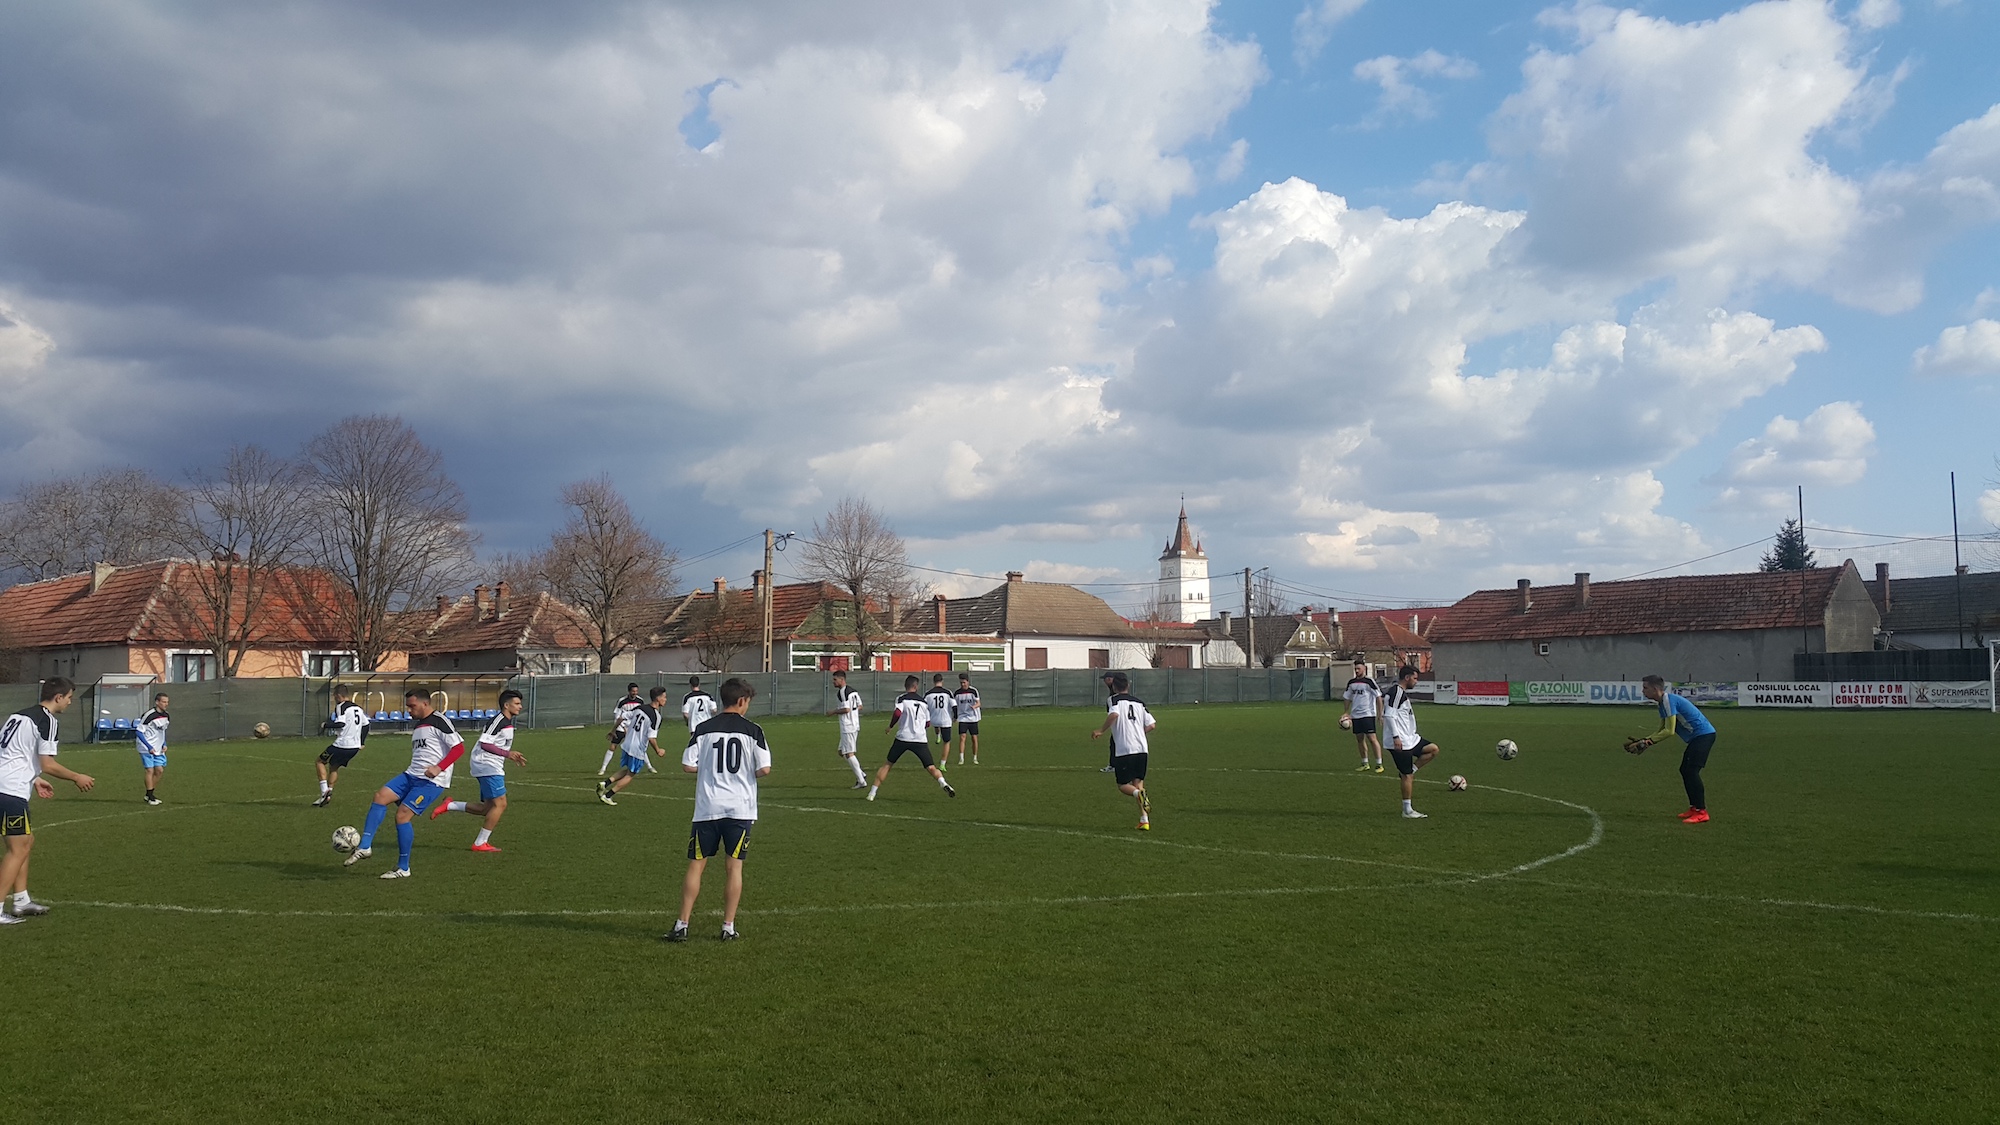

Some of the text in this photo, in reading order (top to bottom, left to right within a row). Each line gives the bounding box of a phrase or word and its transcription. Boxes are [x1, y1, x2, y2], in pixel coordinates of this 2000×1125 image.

[1529, 683, 1585, 694] GAZONUL
[1840, 684, 1903, 694] CLALY COM
[1931, 688, 1990, 697] SUPERMARKET
[697, 698, 704, 712] 2
[933, 695, 944, 709] 18
[1755, 694, 1813, 704] HARMAN
[1835, 695, 1908, 705] CONSTRUCT SRL
[354, 709, 360, 725] 5
[914, 703, 921, 720] 7
[1128, 704, 1136, 721] 4
[632, 713, 645, 732] 15
[712, 737, 742, 774] 10
